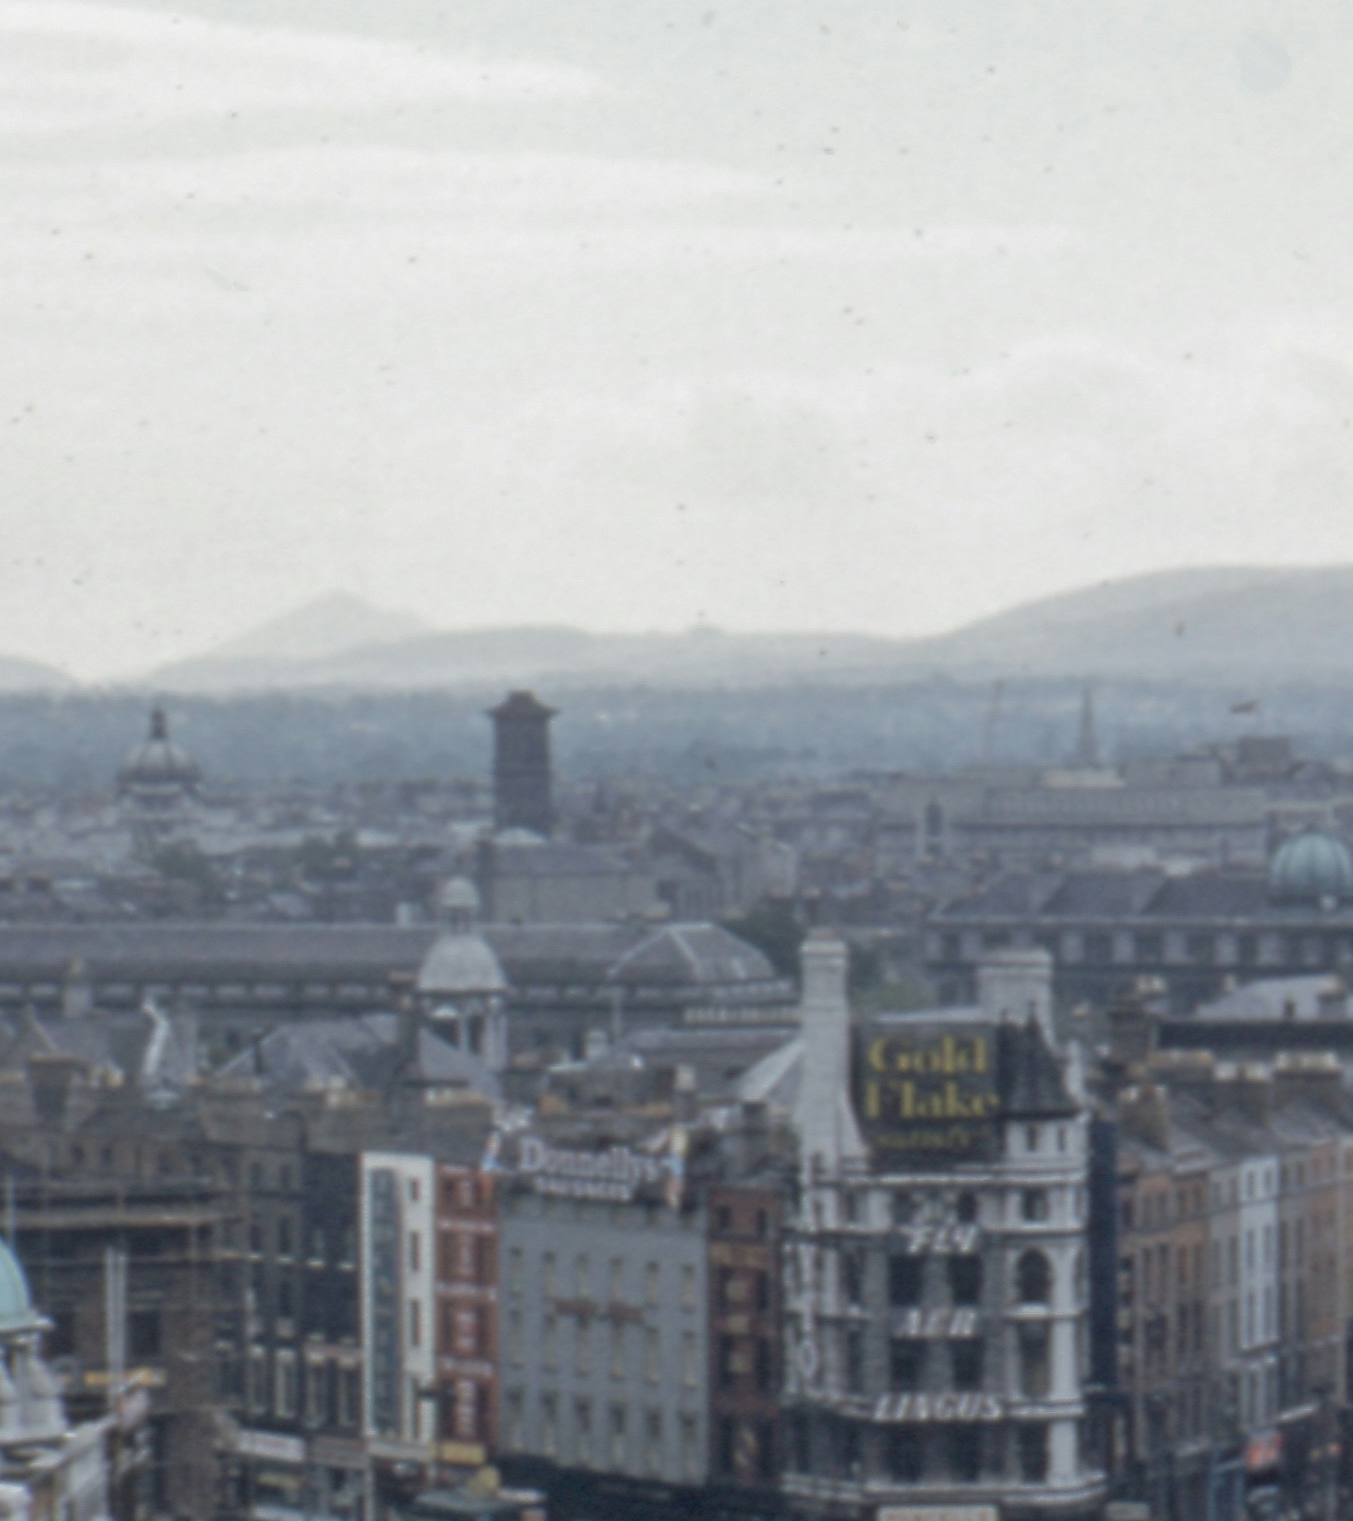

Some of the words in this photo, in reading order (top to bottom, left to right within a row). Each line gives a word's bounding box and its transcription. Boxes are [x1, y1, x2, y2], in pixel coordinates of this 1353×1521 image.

[867, 1034, 988, 1074] Gold
[865, 1081, 1001, 1119] Flake
[873, 1393, 1002, 1422] LINGUS
